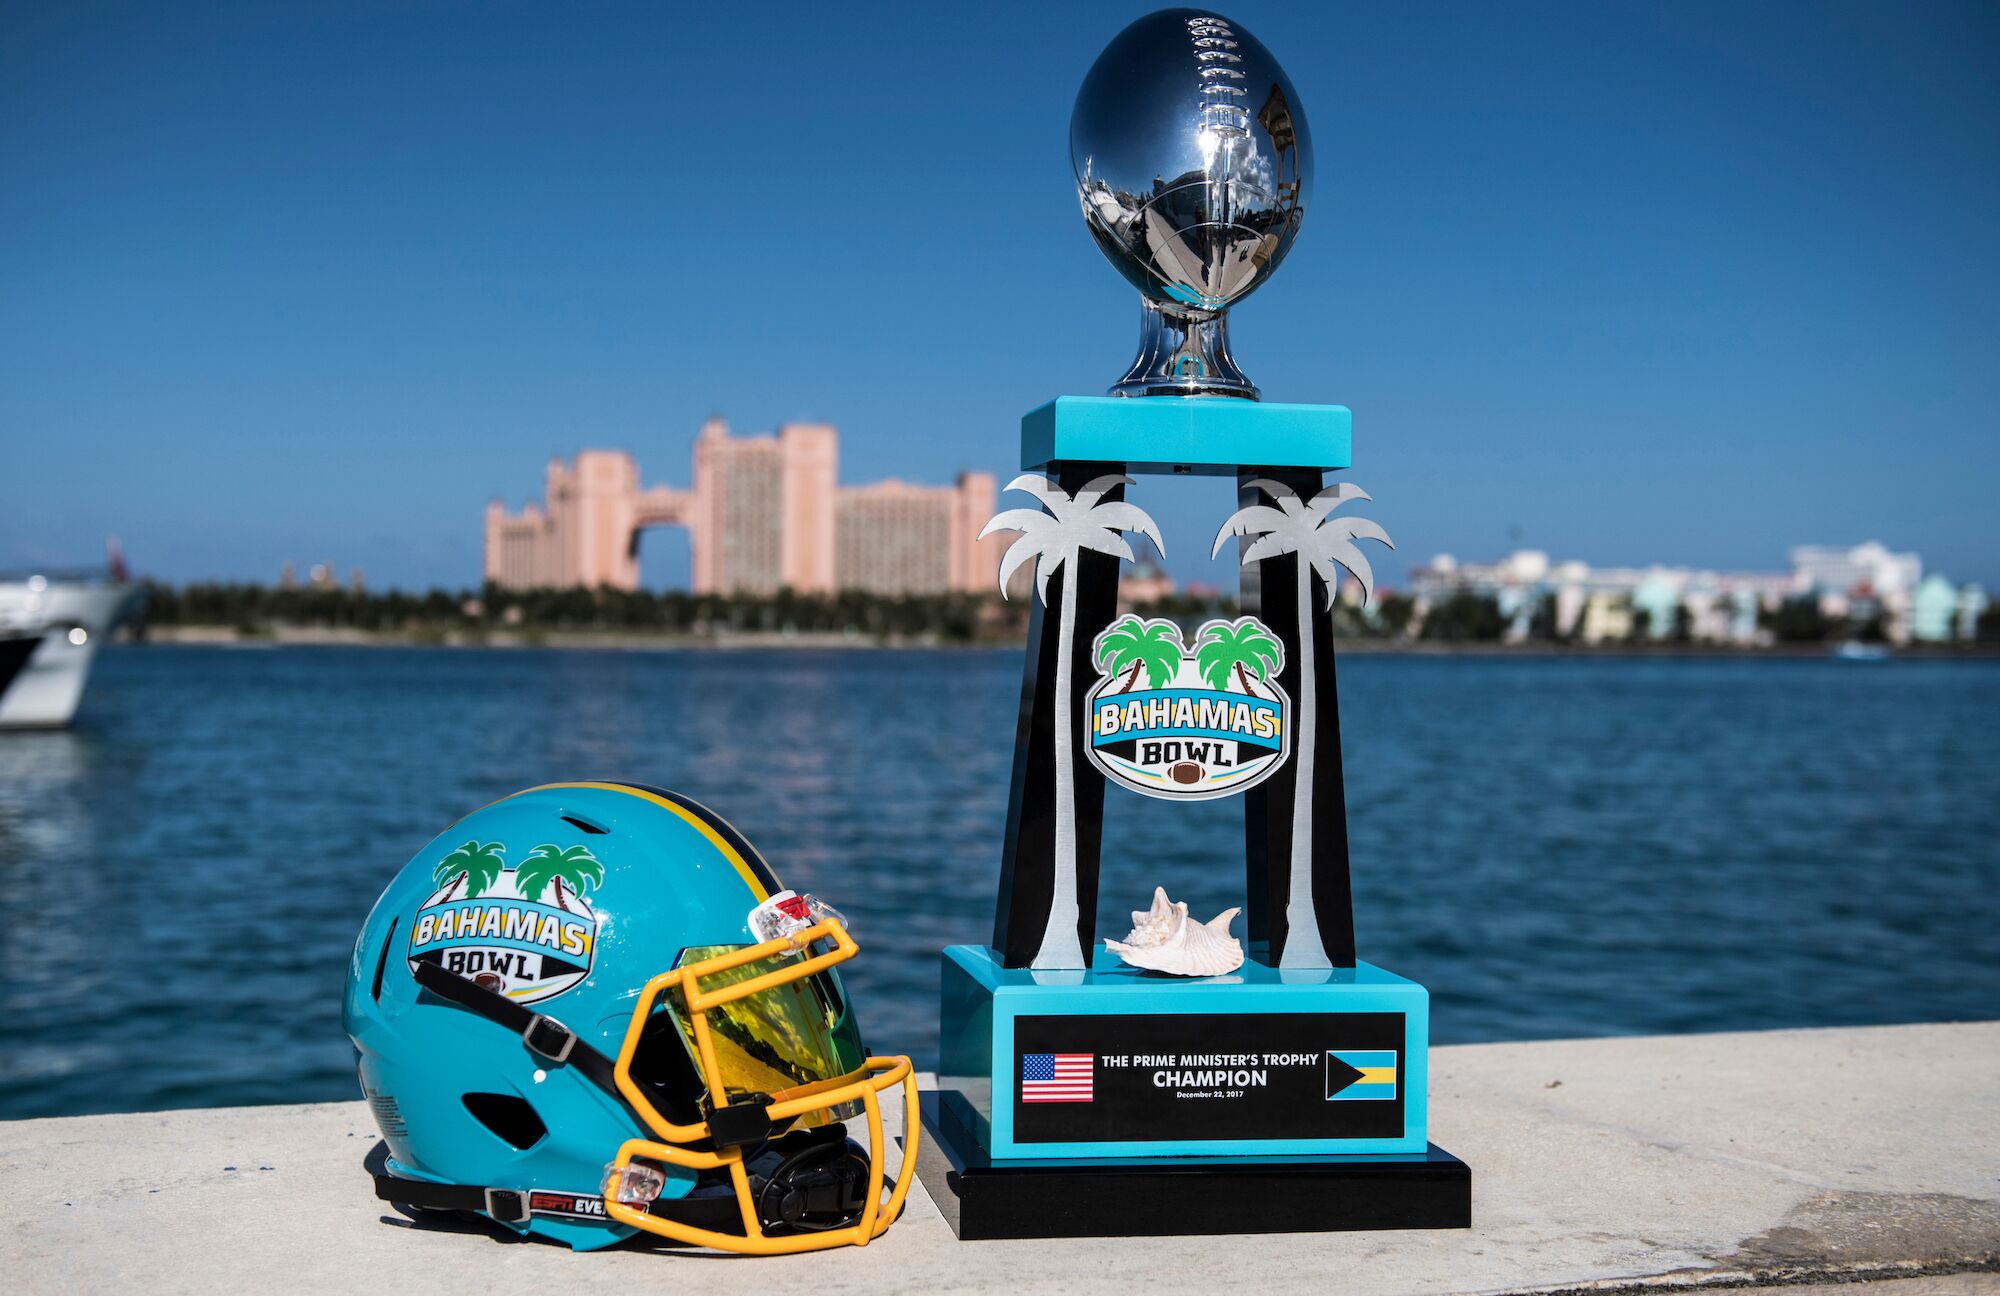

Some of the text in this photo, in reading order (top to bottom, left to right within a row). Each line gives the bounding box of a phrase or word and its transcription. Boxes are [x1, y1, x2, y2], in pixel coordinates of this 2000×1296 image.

[1099, 697, 1275, 740] BAHAMAS
[1141, 741, 1232, 767] BOWL
[415, 906, 586, 957] BAHAMAS
[448, 951, 534, 982] BOWL
[1102, 1053, 1319, 1068] THE PRIME MINISTER'S TROPHY
[1153, 1070, 1268, 1088] CHAMPION
[1176, 1091, 1212, 1099] December
[1213, 1091, 1225, 1099] 22,
[531, 1194, 574, 1211] ESPN
[575, 1199, 606, 1216] EVE
